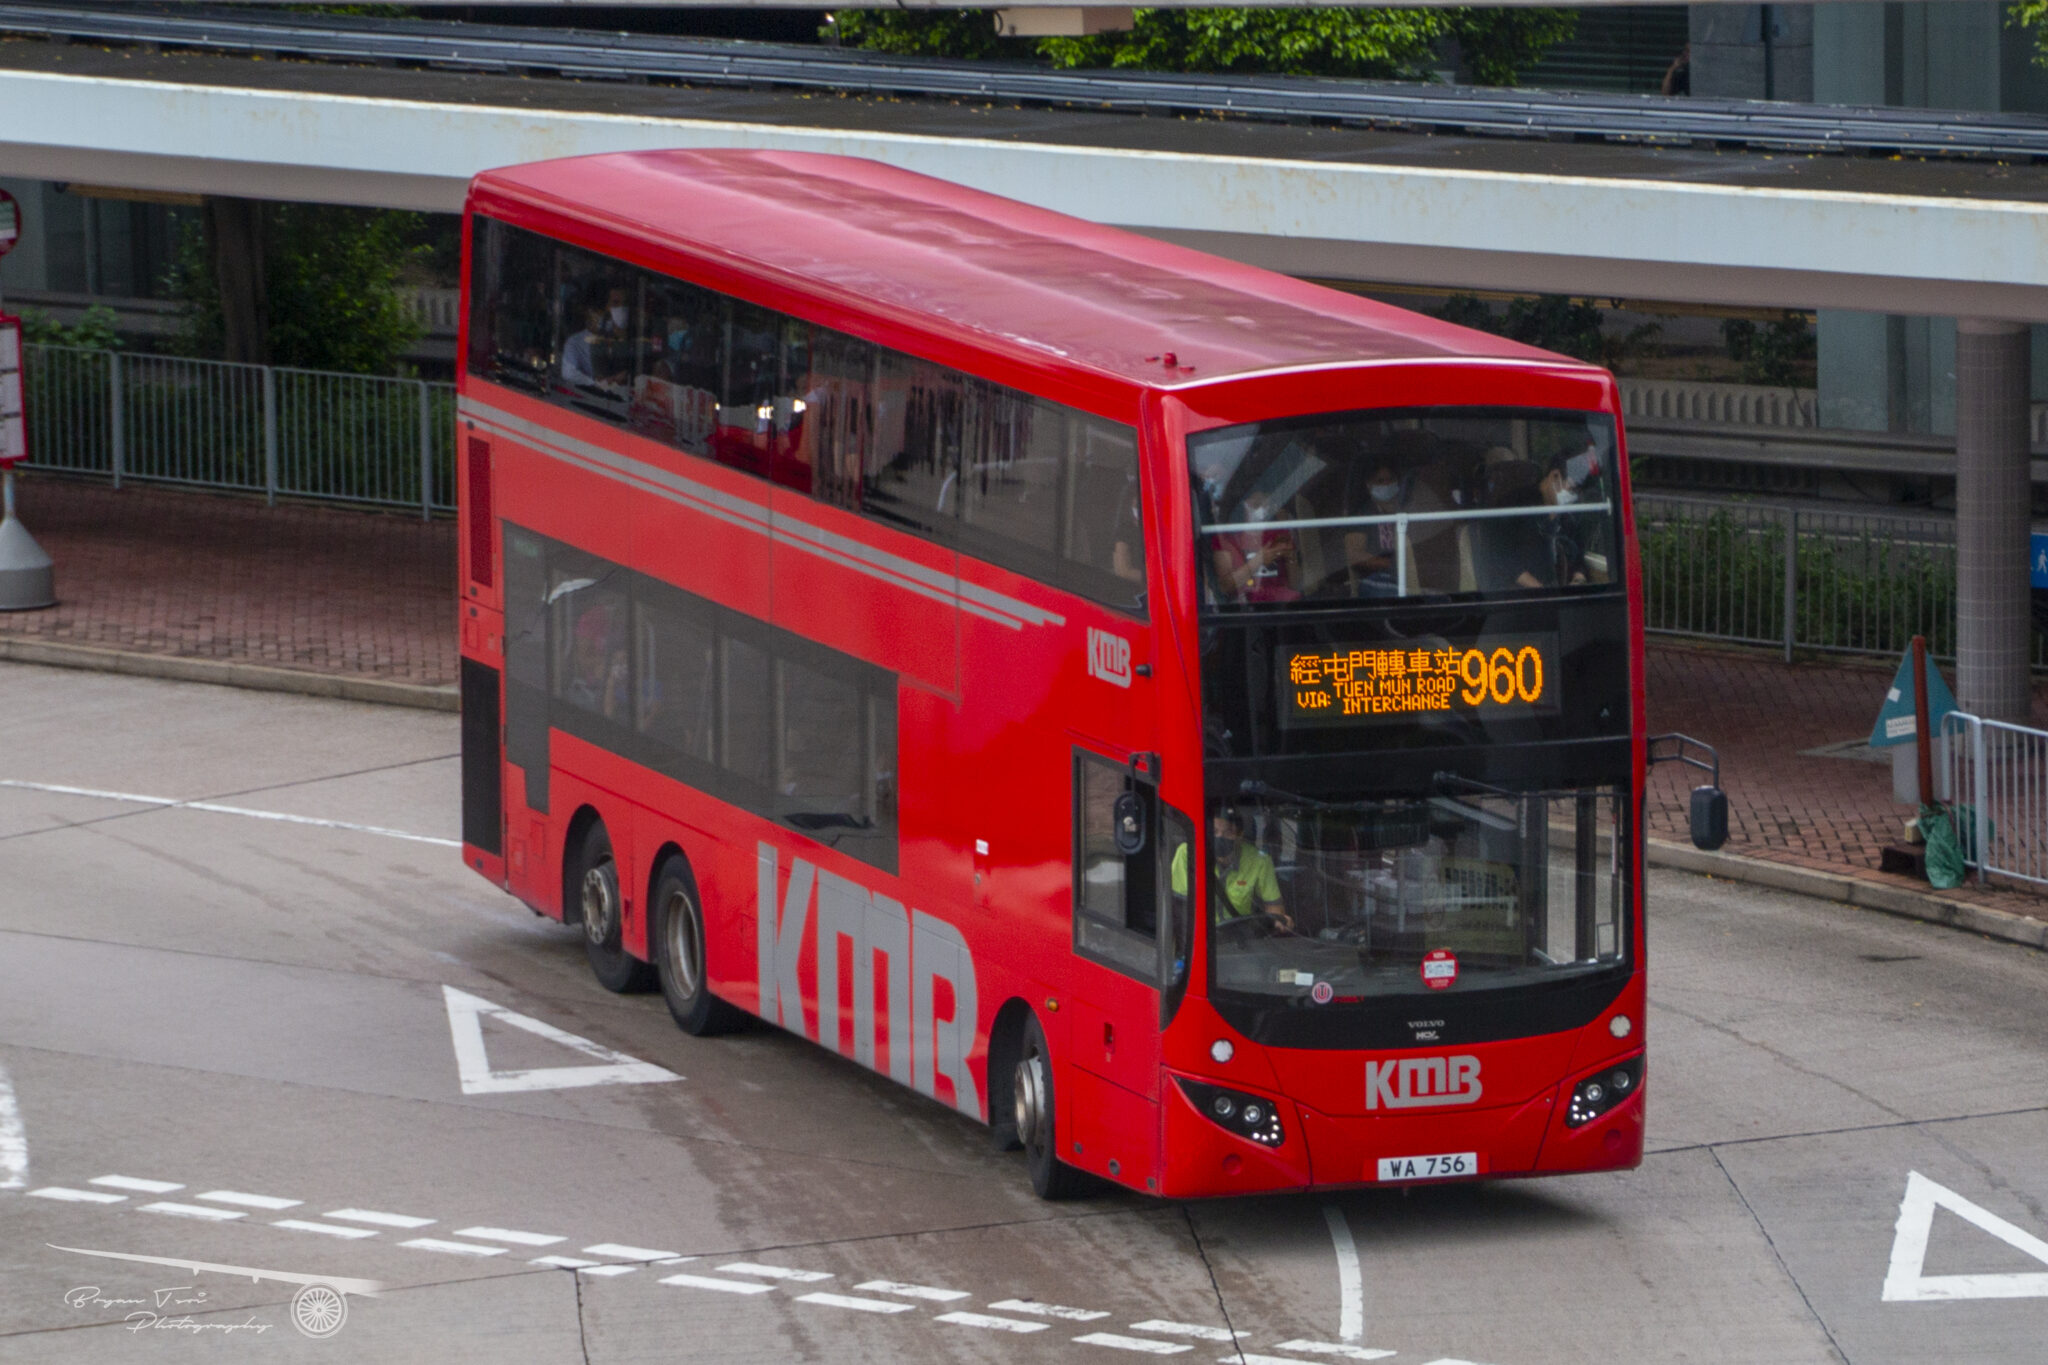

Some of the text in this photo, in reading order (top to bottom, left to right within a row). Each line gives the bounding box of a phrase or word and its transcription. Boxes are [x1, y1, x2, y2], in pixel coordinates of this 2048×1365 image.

[1087, 626, 1132, 689] KMB
[1333, 676, 1456, 698] TUEN MUN ROAD
[1461, 646, 1543, 706] 960
[1297, 690, 1332, 708] VIA:
[1342, 692, 1451, 714] INTERCHANGE
[757, 840, 982, 1123] KMB
[1407, 1019, 1445, 1029] VOLVO
[1365, 1055, 1483, 1110] KMB
[1390, 1155, 1465, 1177] WA 756
